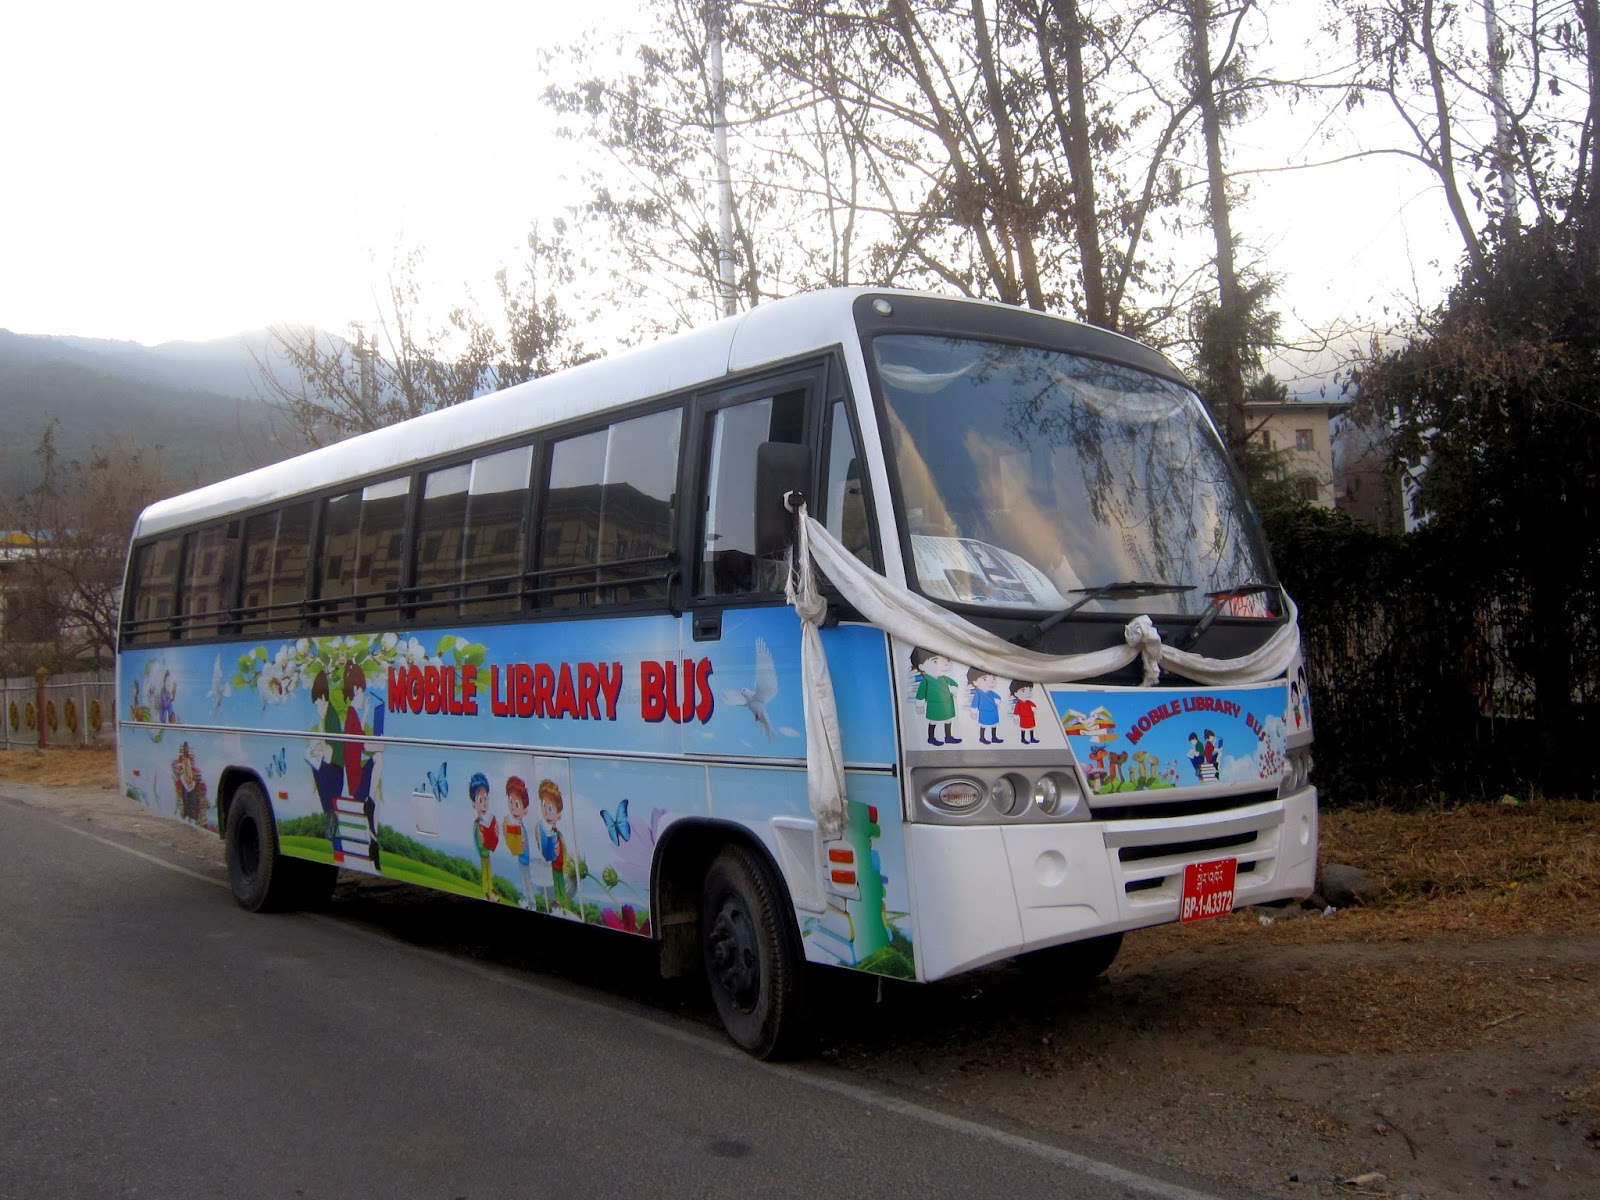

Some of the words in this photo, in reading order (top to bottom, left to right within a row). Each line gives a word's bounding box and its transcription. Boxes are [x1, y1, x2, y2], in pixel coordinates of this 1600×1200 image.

[388, 664, 478, 716] MOBILE
[490, 662, 623, 721] LIBRARY
[640, 657, 714, 725] BUS
[1125, 697, 1182, 745] MOBILE
[1183, 696, 1241, 718] LIBRARY
[1245, 710, 1267, 742] BUS
[1183, 890, 1233, 919] BP-1-A3372
